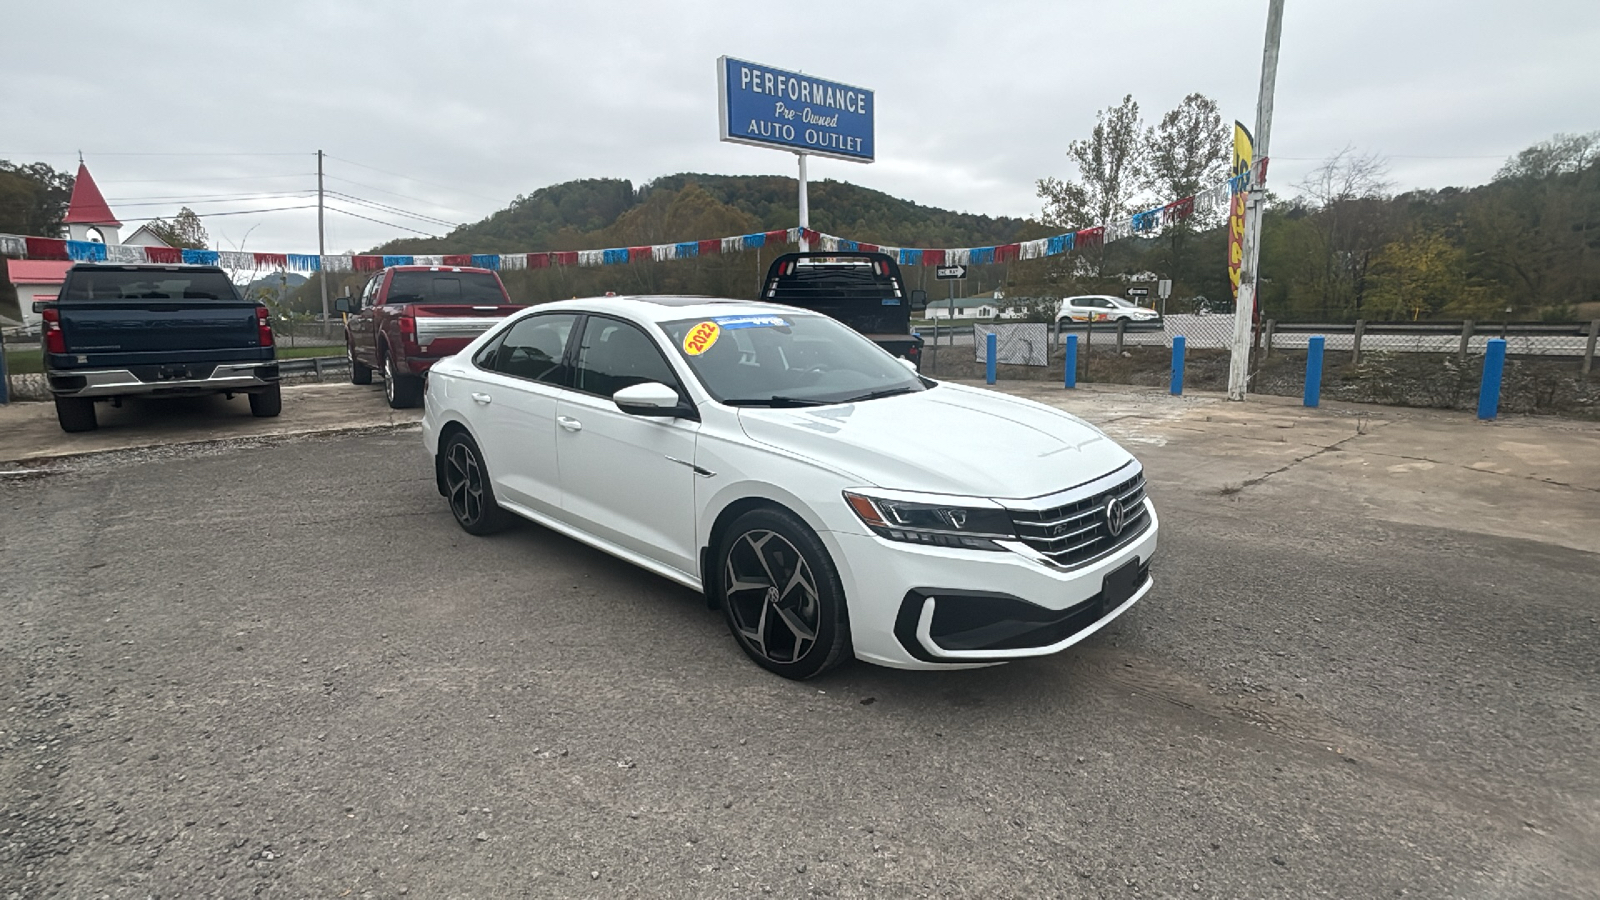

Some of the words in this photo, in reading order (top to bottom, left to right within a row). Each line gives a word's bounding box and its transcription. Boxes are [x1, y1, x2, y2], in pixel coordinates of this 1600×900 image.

[741, 67, 866, 114] PERFORMANCE
[775, 101, 839, 128] Pre-Owned
[748, 119, 795, 141] AUTO
[805, 129, 863, 152] OUTLET
[688, 323, 716, 352] 2022
